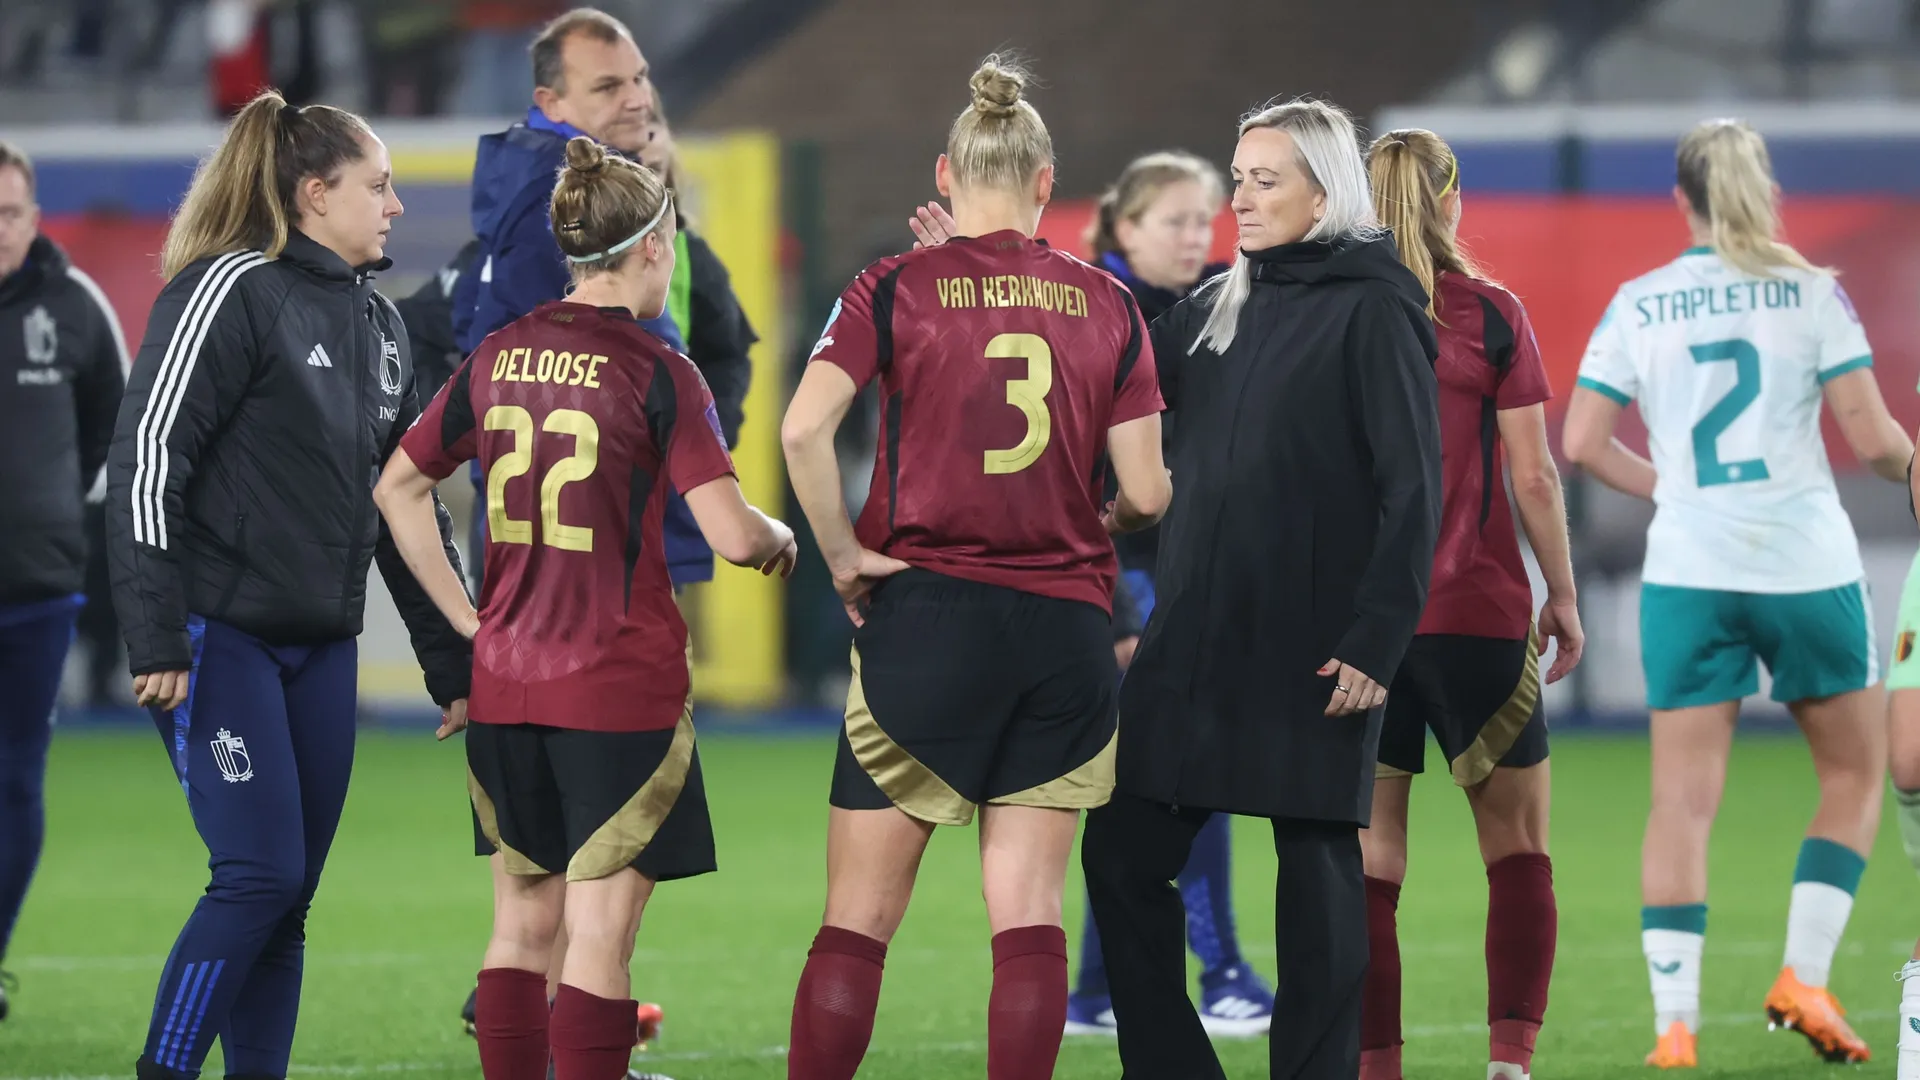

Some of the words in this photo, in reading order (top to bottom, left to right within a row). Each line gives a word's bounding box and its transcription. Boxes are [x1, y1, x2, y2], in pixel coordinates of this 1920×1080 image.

[936, 276, 976, 309] VAN
[981, 275, 1089, 318] KERKHOVEN
[1635, 280, 1802, 329] STAPLETON
[491, 347, 609, 389] DELOOSE
[378, 405, 397, 422] ING
[984, 333, 1053, 475] 3
[1688, 338, 1771, 489] 2
[483, 405, 600, 553] 22
